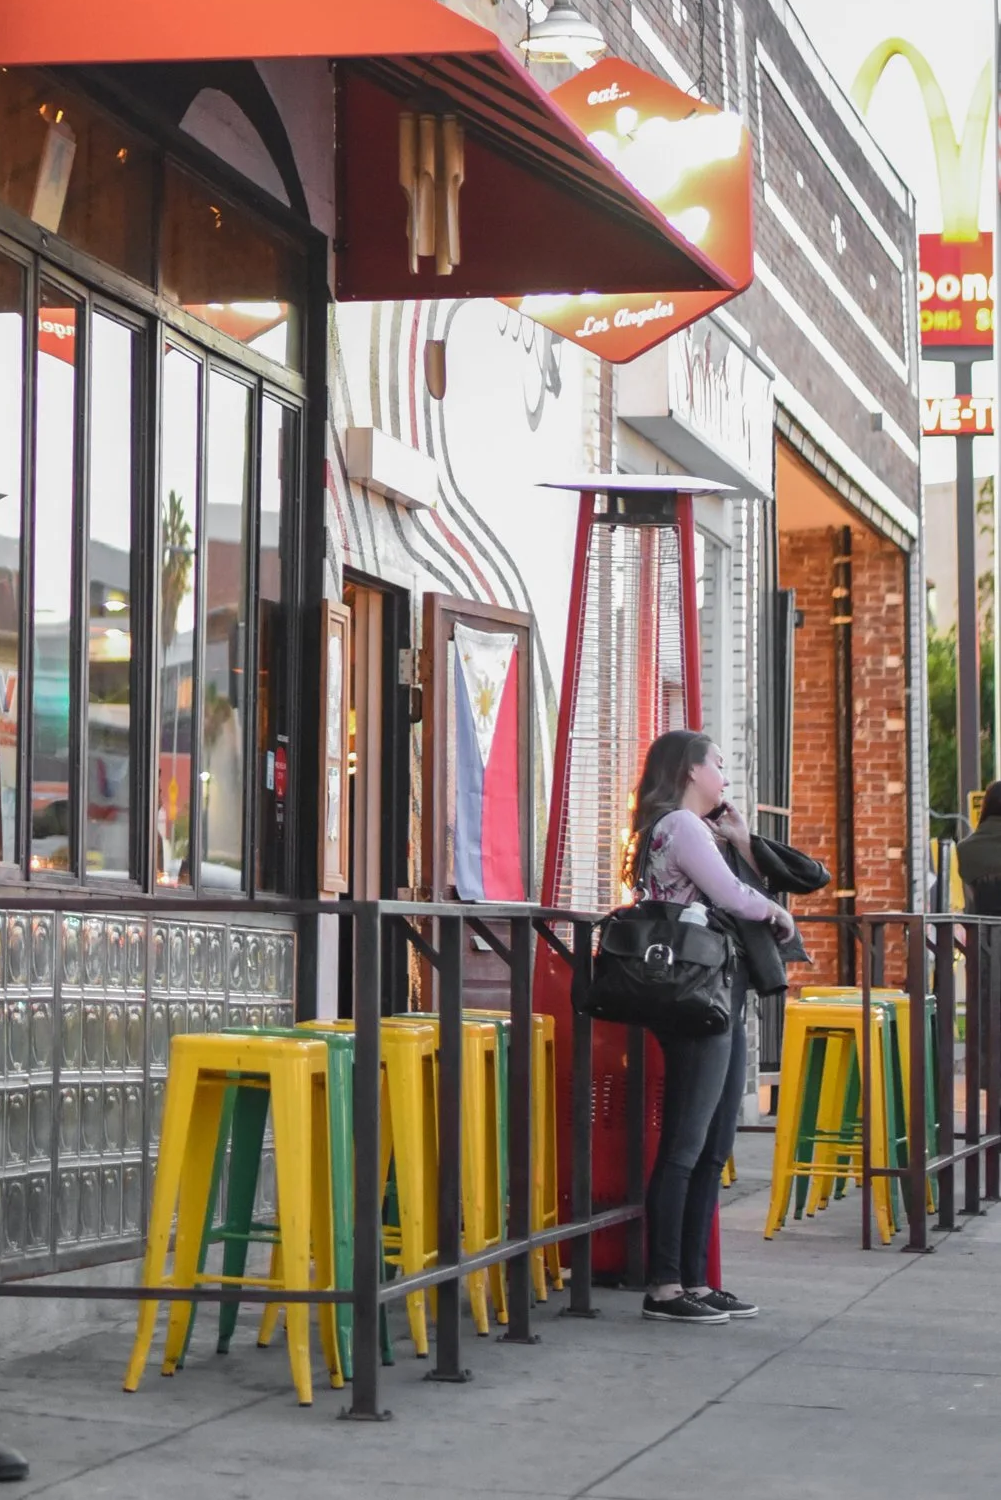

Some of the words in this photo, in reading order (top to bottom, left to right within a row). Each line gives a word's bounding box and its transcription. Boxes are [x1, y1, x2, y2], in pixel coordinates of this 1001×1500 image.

[917, 271, 994, 302] Don
[575, 316, 610, 337] Los
[614, 300, 674, 328] Angeles
[920, 399, 995, 431] VE-T
